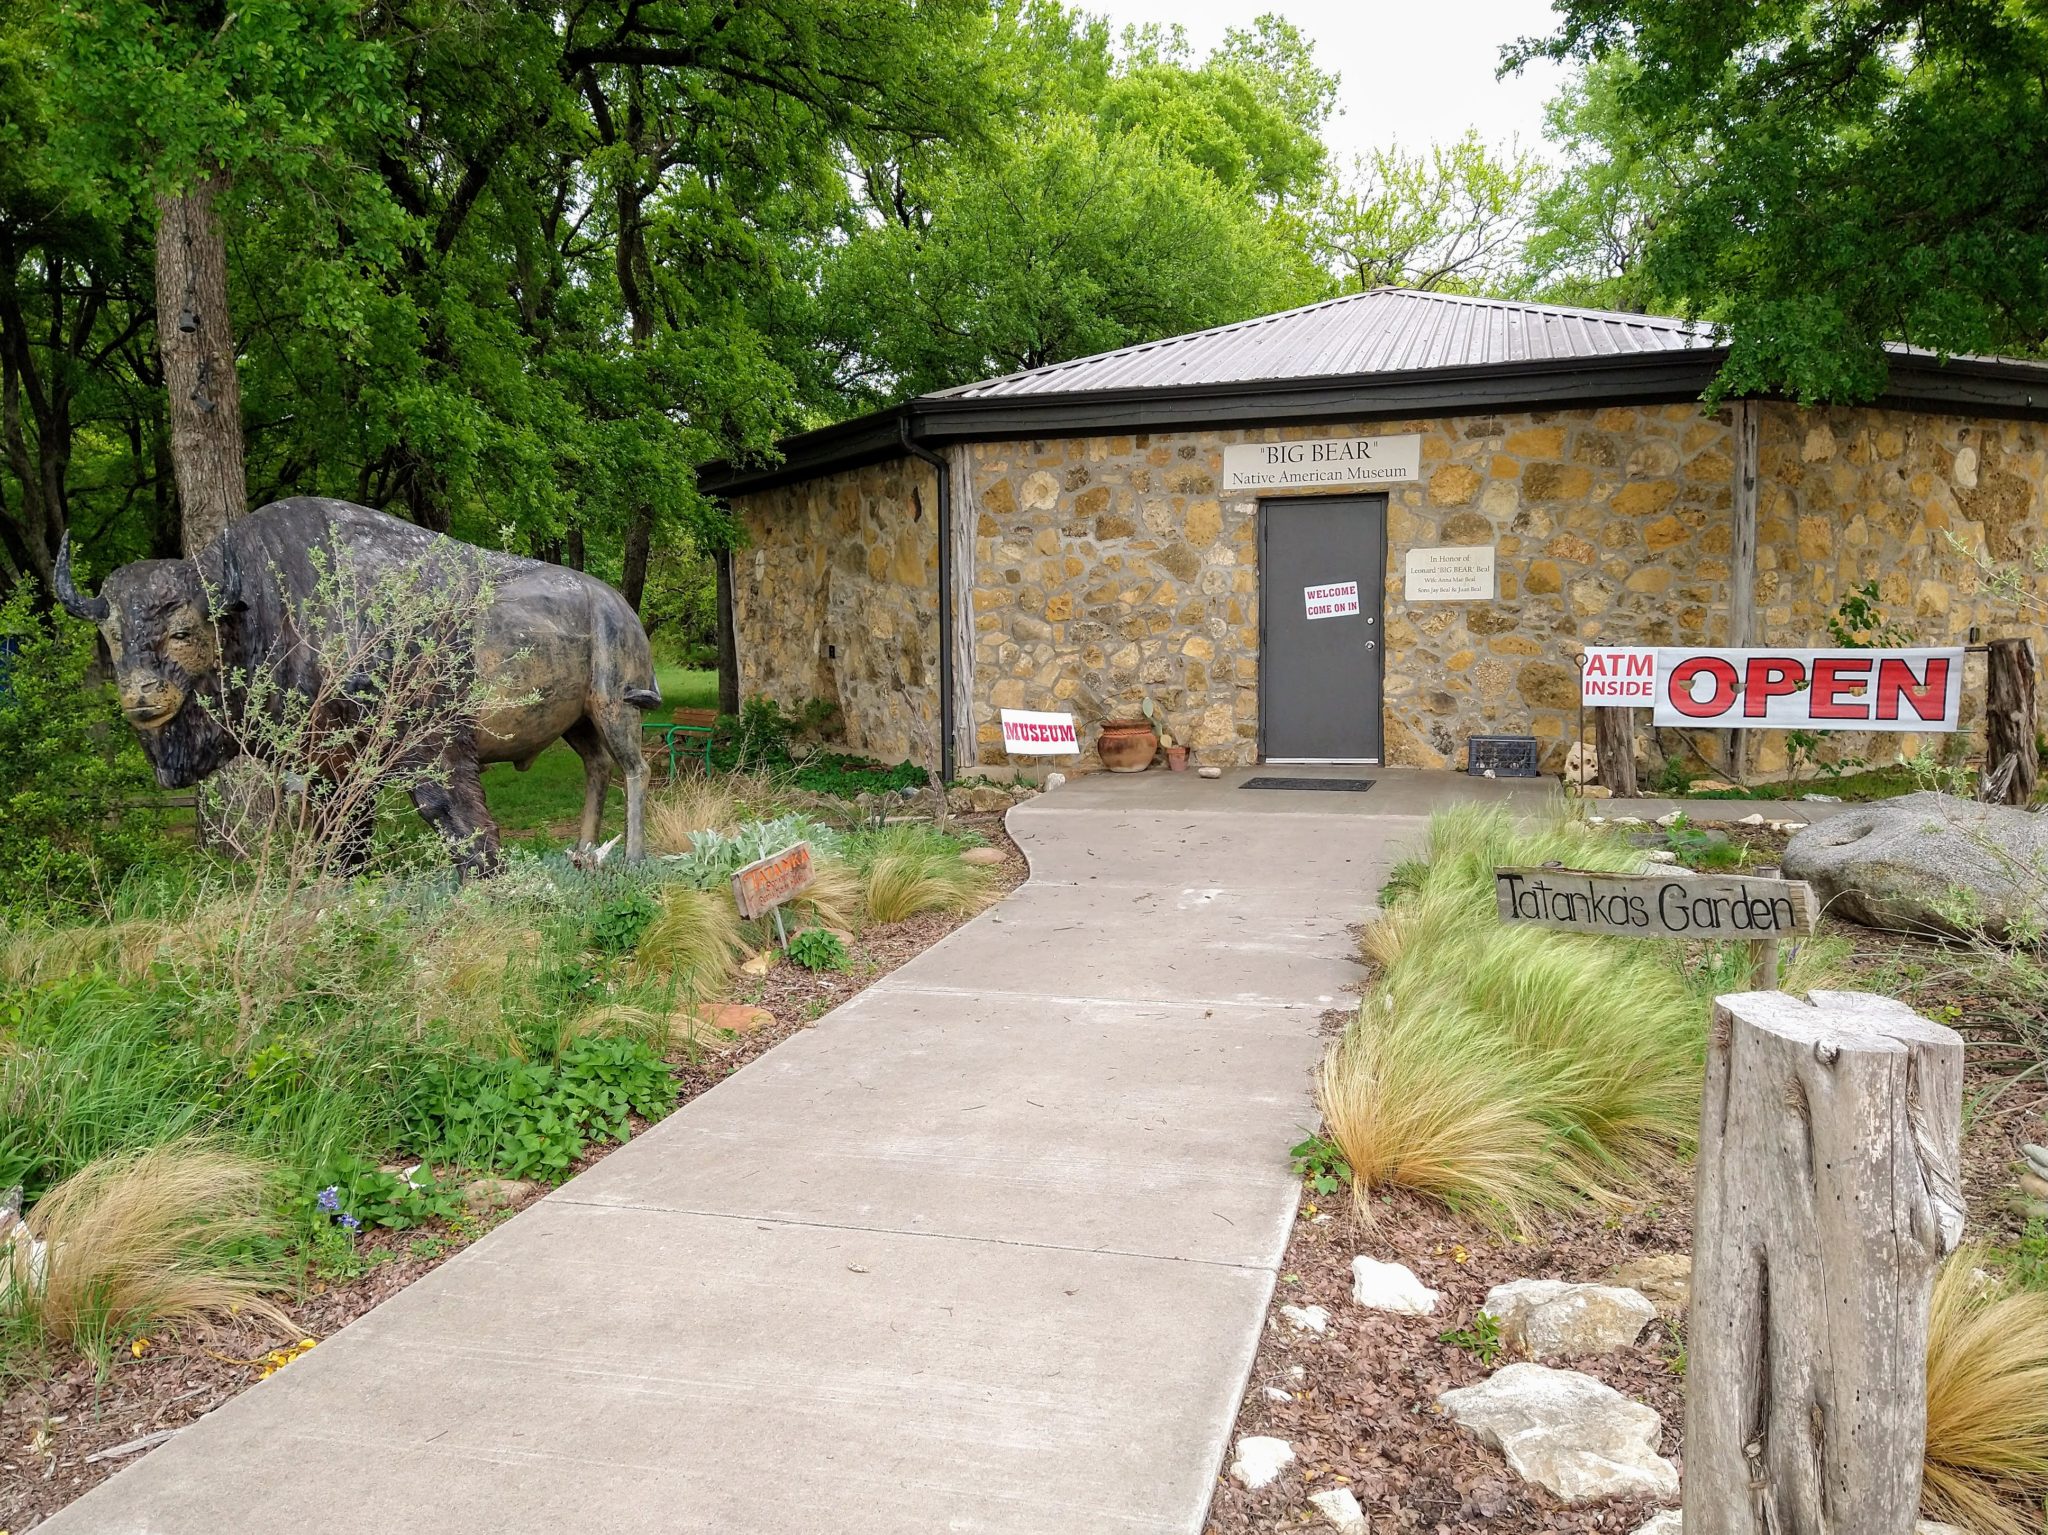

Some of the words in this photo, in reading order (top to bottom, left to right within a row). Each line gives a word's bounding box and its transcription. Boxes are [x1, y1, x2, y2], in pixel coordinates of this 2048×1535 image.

[1232, 472, 1275, 485] Native
[1279, 470, 1342, 483] American
[1347, 466, 1407, 480] Museum
[1307, 586, 1356, 600] WELCOME
[1308, 605, 1332, 615] COME
[1334, 603, 1346, 612] ON
[1348, 602, 1357, 610] IN
[1586, 653, 1654, 677] ATM
[1585, 681, 1653, 697] INSIDE
[1667, 656, 1951, 722] OPEN
[1004, 722, 1075, 742] MUSEUM
[1658, 883, 1798, 931] Garden
